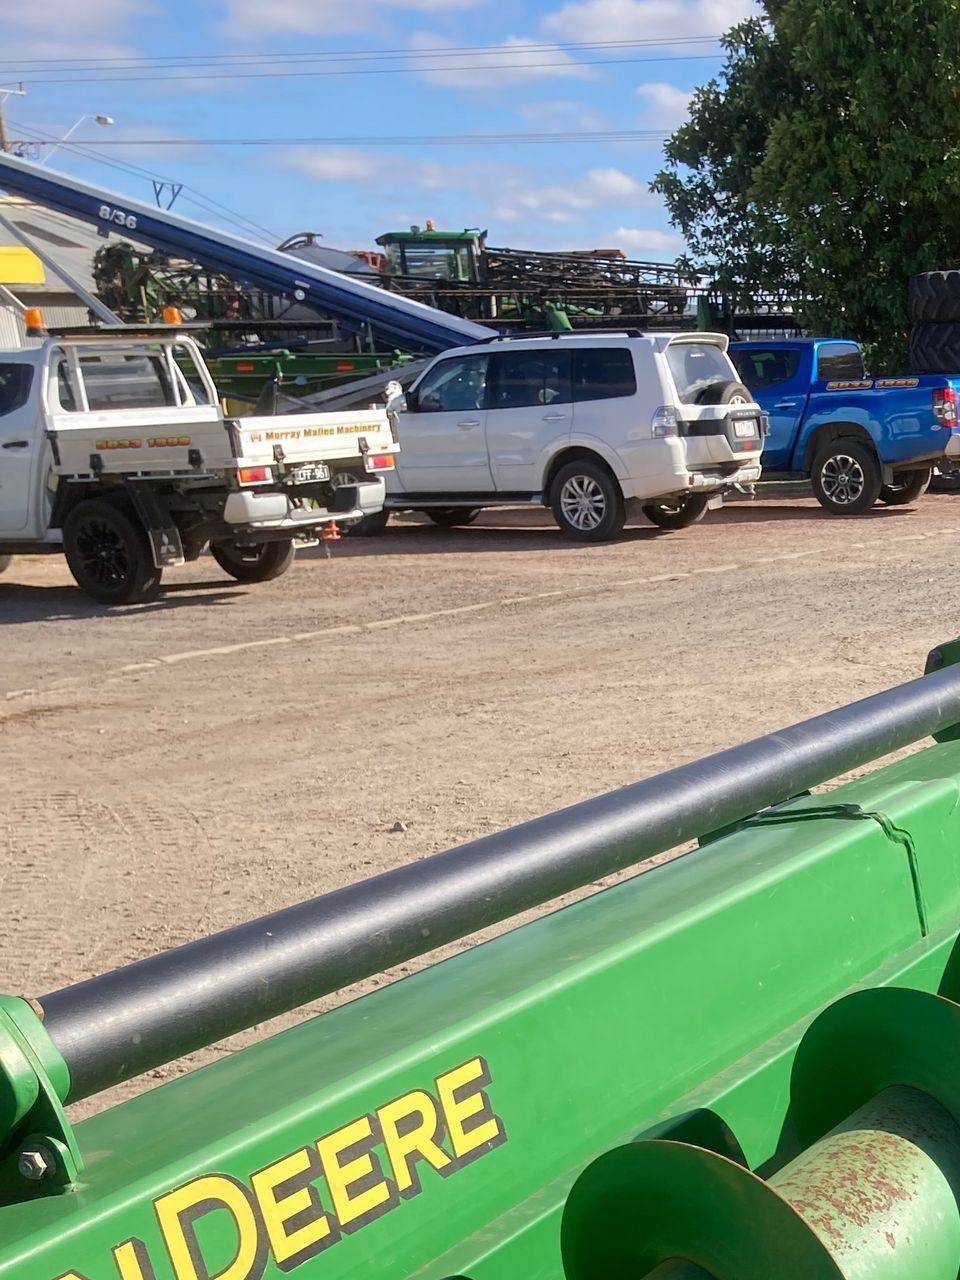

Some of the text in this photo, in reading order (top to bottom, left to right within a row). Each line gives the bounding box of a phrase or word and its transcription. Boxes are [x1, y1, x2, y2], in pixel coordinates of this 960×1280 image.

[98, 204, 138, 230] 8/36
[265, 423, 382, 440] Murray Mallee Machinery
